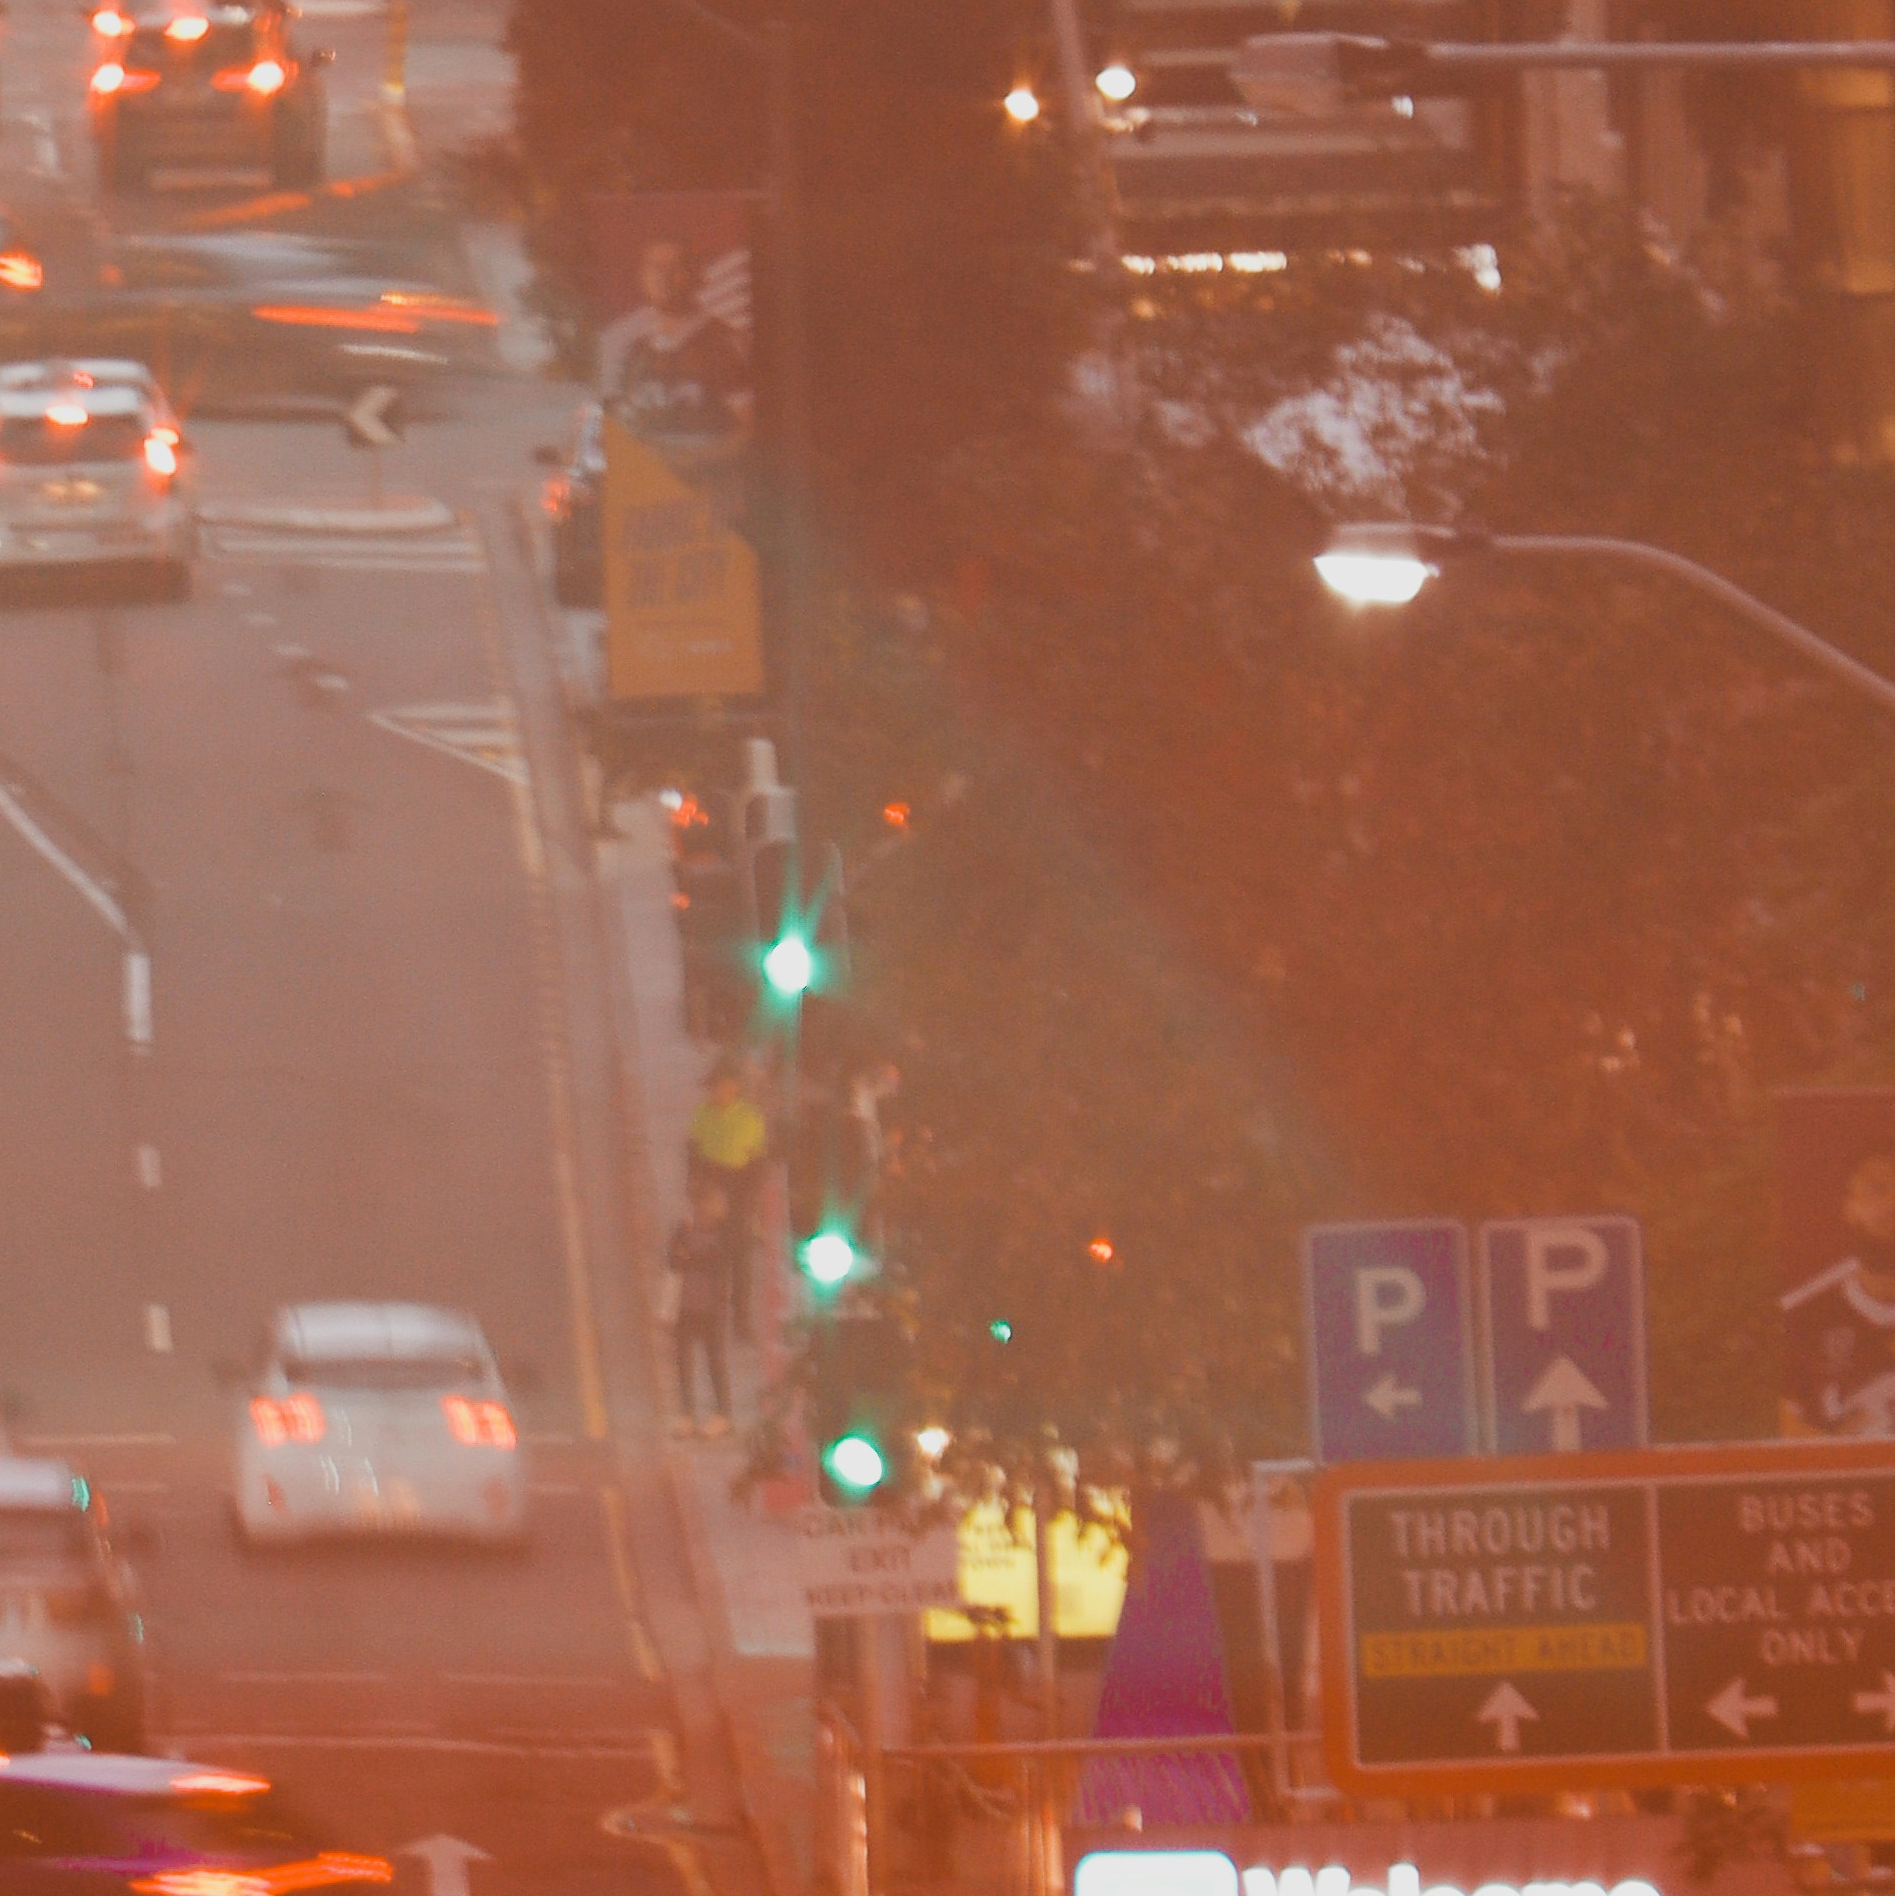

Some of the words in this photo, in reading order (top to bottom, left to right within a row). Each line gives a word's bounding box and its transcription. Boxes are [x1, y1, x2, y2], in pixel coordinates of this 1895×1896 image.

[1526, 1228, 1608, 1331] P
[1356, 1266, 1426, 1356] P
[1387, 1503, 1611, 1558] THROUGH
[1738, 1489, 1875, 1533] BUSES
[1765, 1535, 1852, 1576] AND
[1400, 1562, 1597, 1617] TRAFFIC
[1665, 1583, 1790, 1625] LOCAL
[1370, 1634, 1516, 1670] STRAIGHT
[1538, 1629, 1639, 1661] AHEAD
[1759, 1627, 1865, 1668] ONLY
